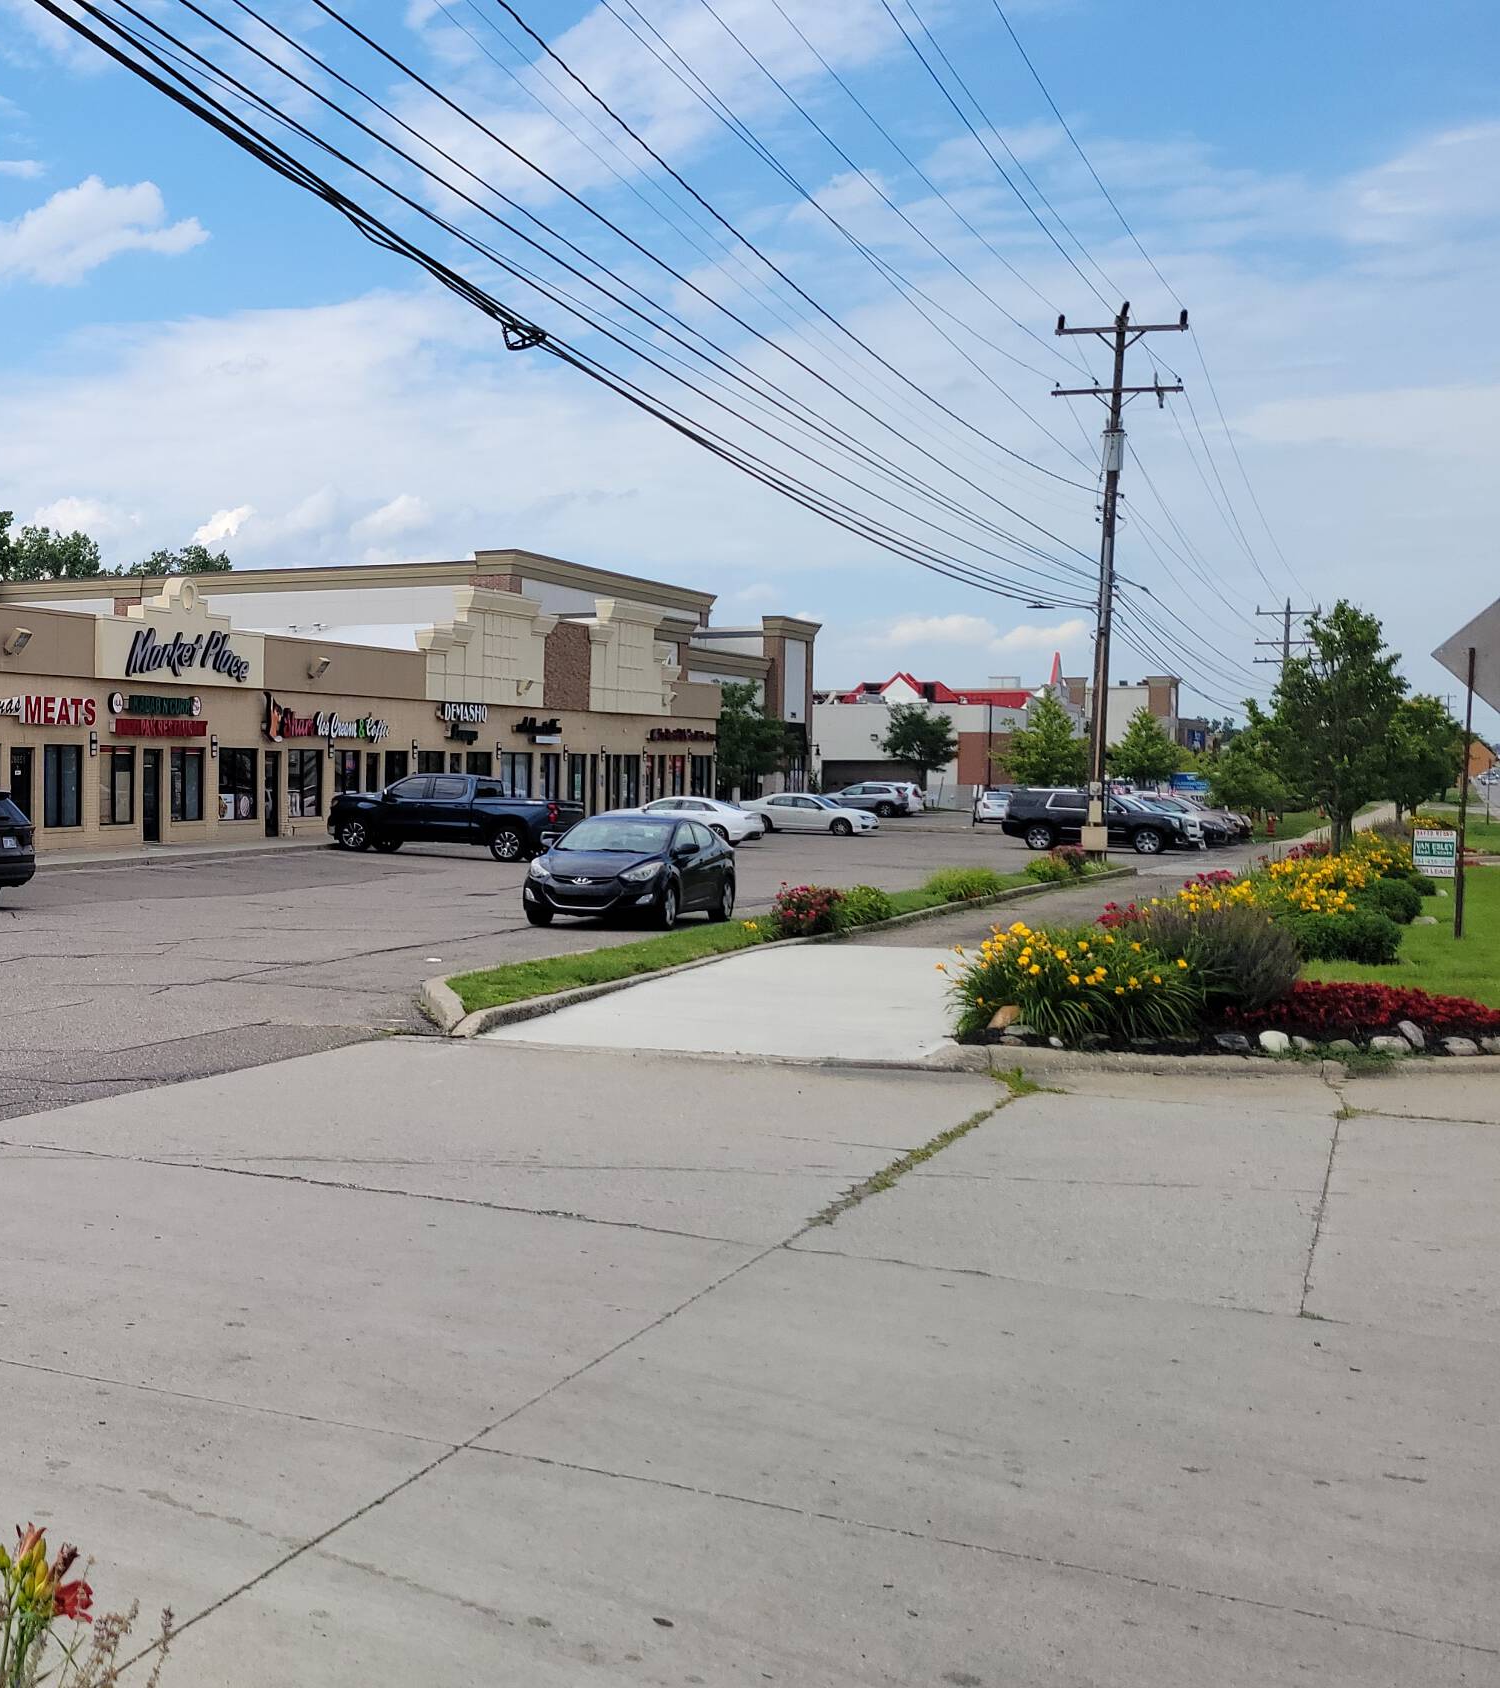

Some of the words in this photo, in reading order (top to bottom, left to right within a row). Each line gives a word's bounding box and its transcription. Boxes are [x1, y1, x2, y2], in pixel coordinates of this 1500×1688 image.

[125, 627, 204, 677] Market
[200, 630, 250, 682] Place
[23, 695, 97, 727] MEATS
[170, 698, 192, 715] CURR
[444, 702, 488, 724] DEMASHQ
[357, 718, 366, 738] &
[1416, 842, 1430, 850] VAN
